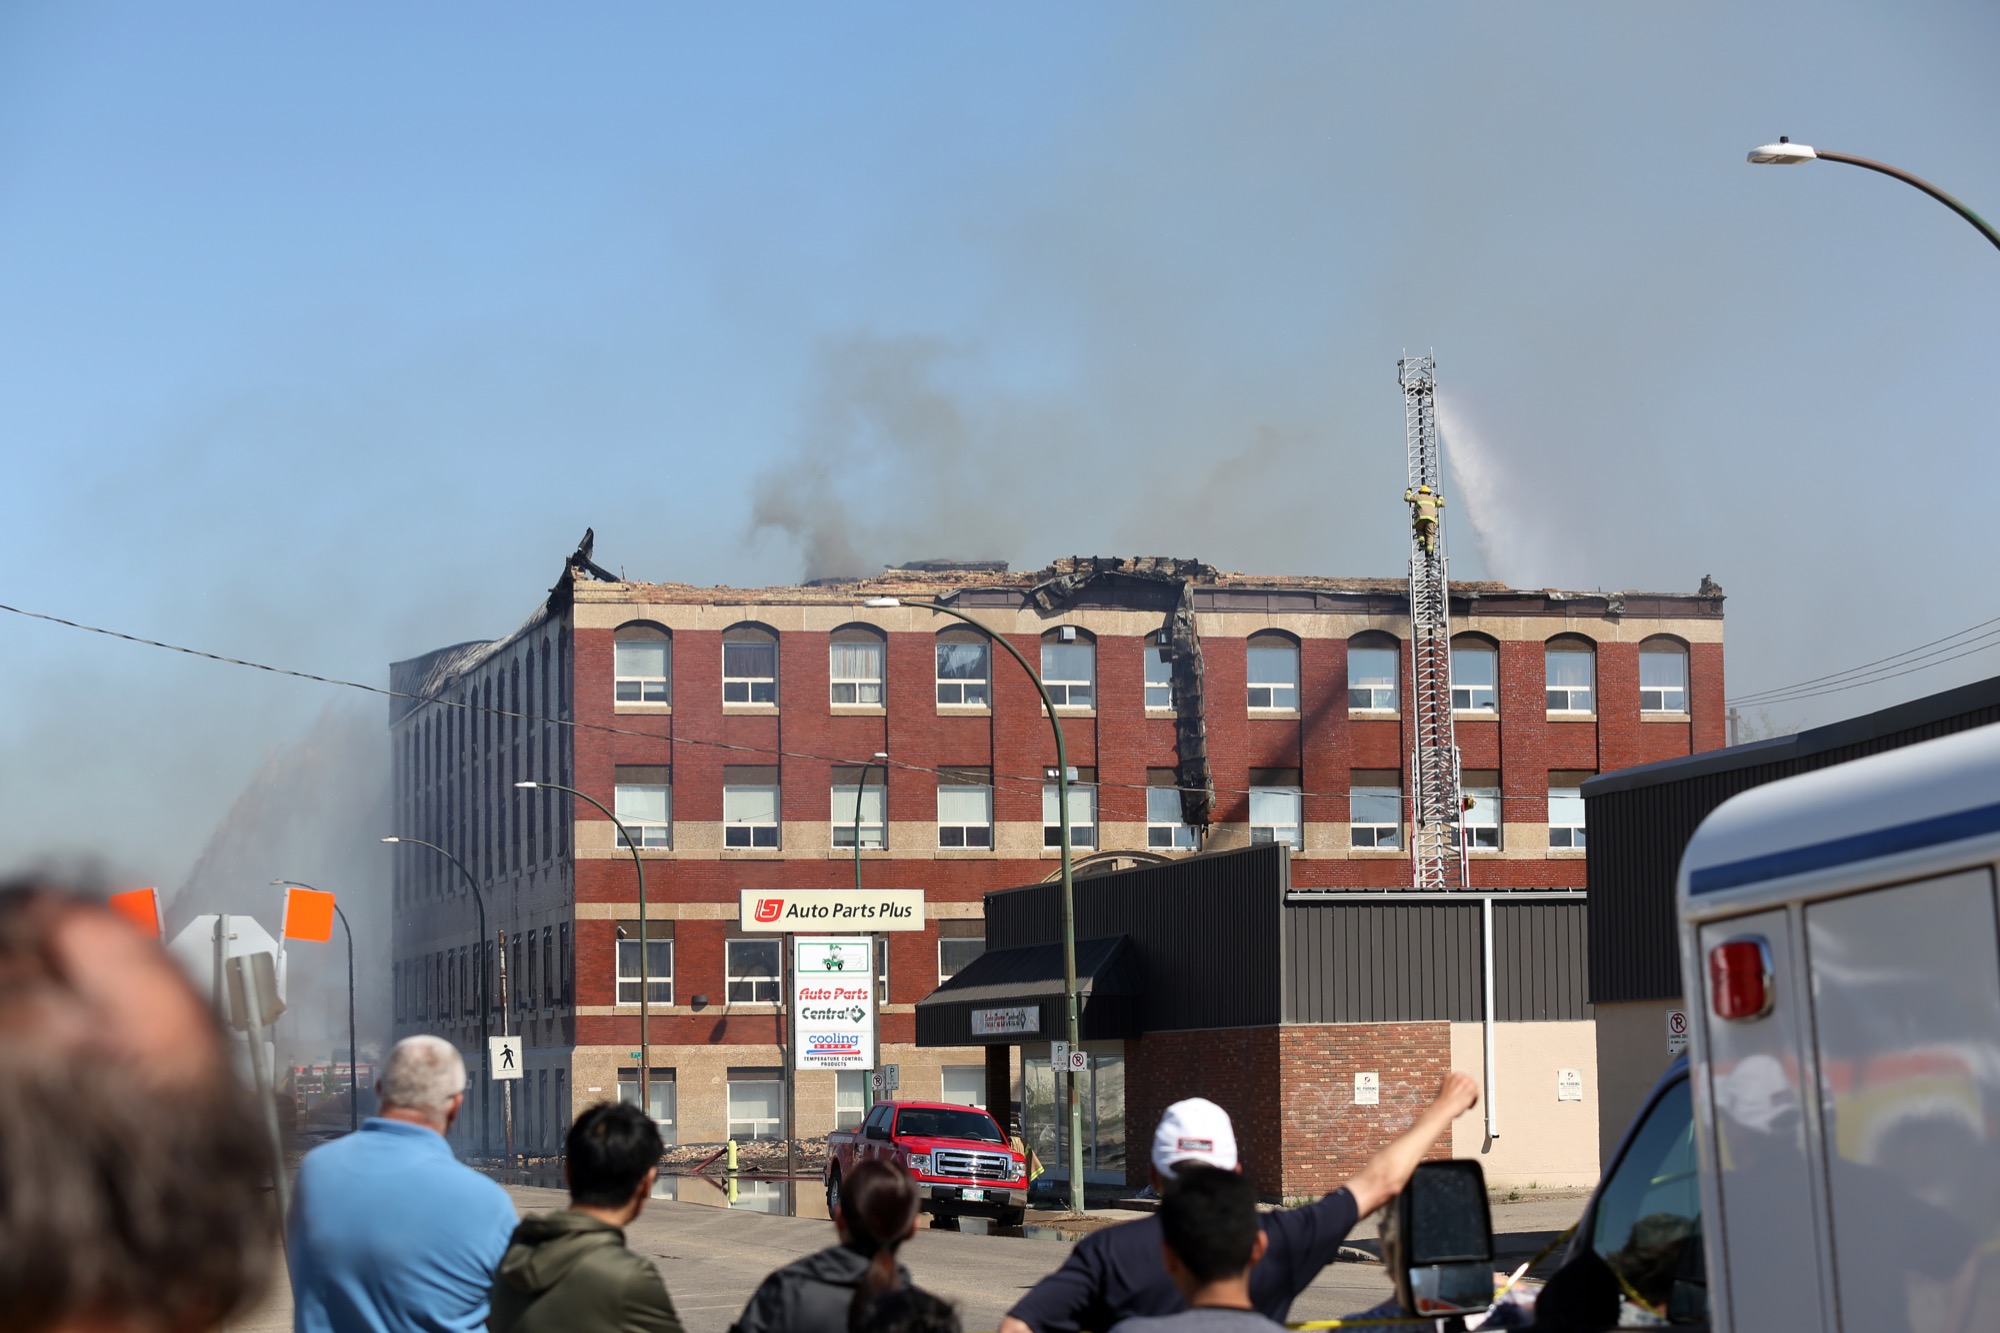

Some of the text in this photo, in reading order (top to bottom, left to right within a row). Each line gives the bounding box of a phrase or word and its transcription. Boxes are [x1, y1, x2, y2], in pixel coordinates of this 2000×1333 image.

[786, 903, 829, 918] Auto
[832, 902, 876, 918] Parts
[879, 902, 912, 918] Plus
[799, 988, 868, 1000] Auto Parts
[802, 1007, 849, 1020] Central
[809, 1033, 859, 1046] cooling
